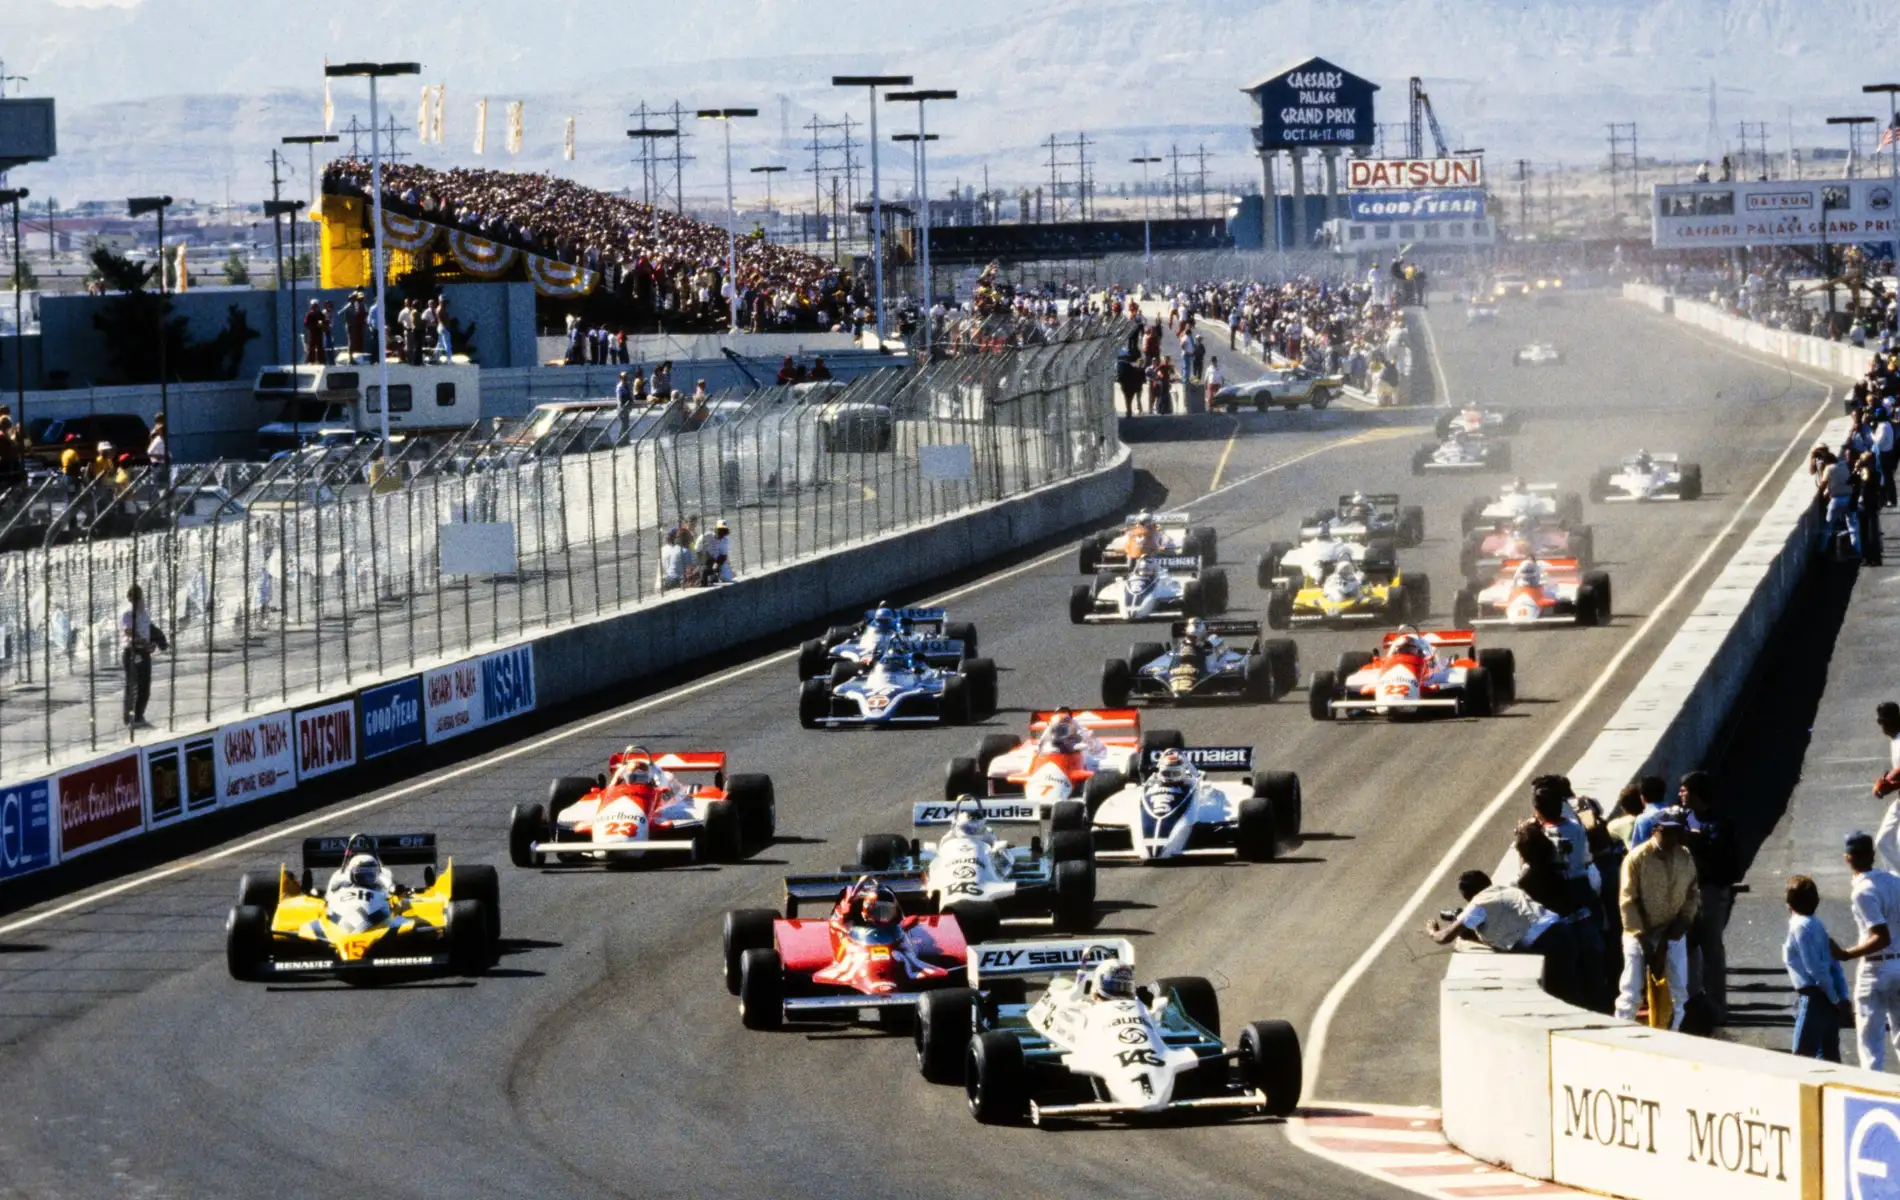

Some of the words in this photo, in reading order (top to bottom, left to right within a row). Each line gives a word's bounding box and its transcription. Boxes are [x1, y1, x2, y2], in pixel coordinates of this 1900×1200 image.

[1286, 72, 1343, 89] CAESARS
[1299, 91, 1336, 104] PALACE
[1280, 107, 1324, 124] GRAND
[1326, 107, 1356, 124] PRIX
[1336, 128, 1355, 140] 1981
[1351, 160, 1477, 186] DATSUN
[1750, 196, 1809, 207] DATSUN
[1676, 223, 1738, 237] CAESARS
[1747, 222, 1803, 235] PALACE
[1808, 220, 1859, 234] GRAND
[1864, 219, 1894, 232] PRI
[482, 647, 533, 722] NISSAN
[1384, 684, 1410, 697] 22
[224, 727, 257, 767] CAESARS
[259, 720, 289, 759] TAHOE
[301, 709, 352, 773] DATSUN
[1150, 749, 1247, 763] prmalat
[1040, 784, 1054, 797] 7
[921, 807, 955, 820] FLY
[604, 822, 638, 838] 23
[344, 941, 367, 958] 15
[980, 949, 1025, 967] FLY
[275, 960, 333, 971] RENAULT
[373, 957, 433, 967] MICHELIN
[1130, 1072, 1154, 1100] 1
[1563, 1083, 1662, 1155] MOËT
[1686, 1107, 1792, 1183] MOËT
